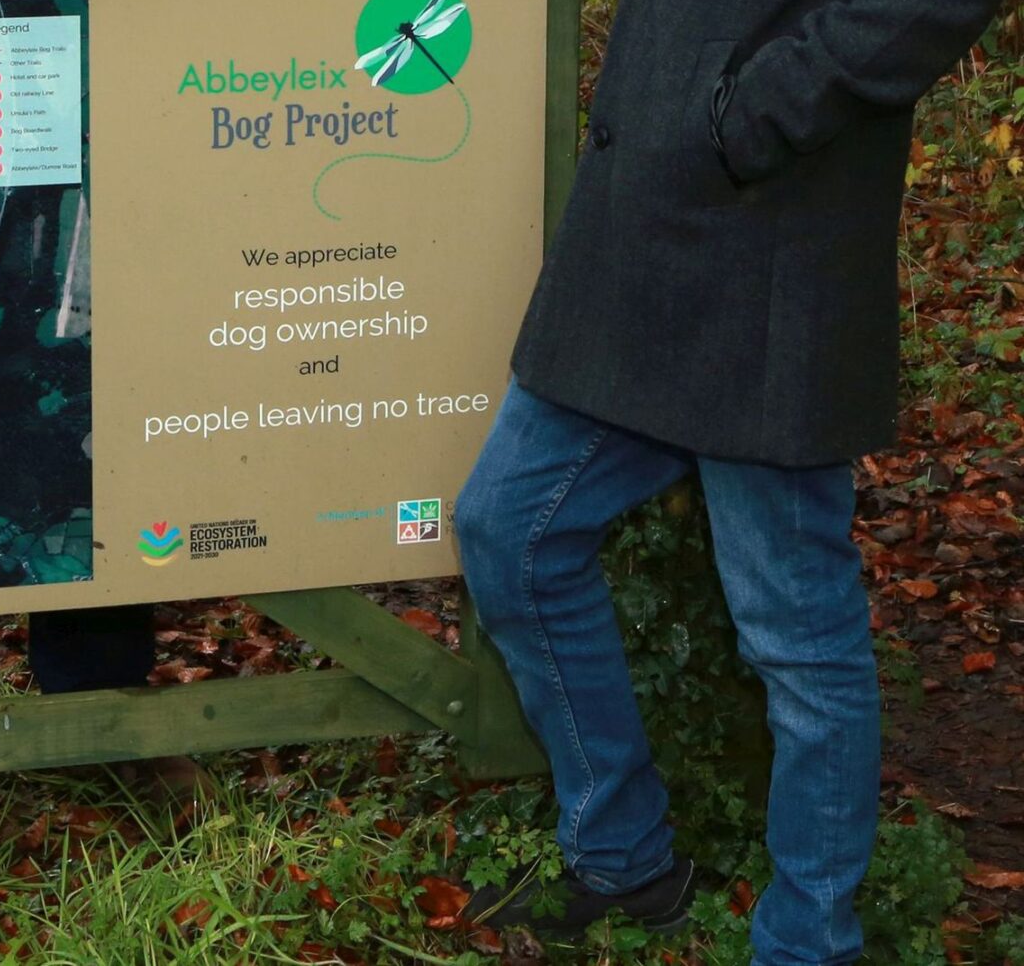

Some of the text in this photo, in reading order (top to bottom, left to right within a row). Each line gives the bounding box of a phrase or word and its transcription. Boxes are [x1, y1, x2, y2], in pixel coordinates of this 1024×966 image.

[178, 57, 346, 100] Abbeyleix
[211, 101, 399, 149] Bog Project
[241, 242, 397, 268] We appreciate
[235, 275, 405, 313] responsible
[209, 310, 428, 351] dog ownership
[299, 354, 339, 375] and
[145, 393, 489, 442] people leaving no trace
[190, 526, 256, 540] ECOSYSTEM
[190, 536, 267, 552] RESTORATION
